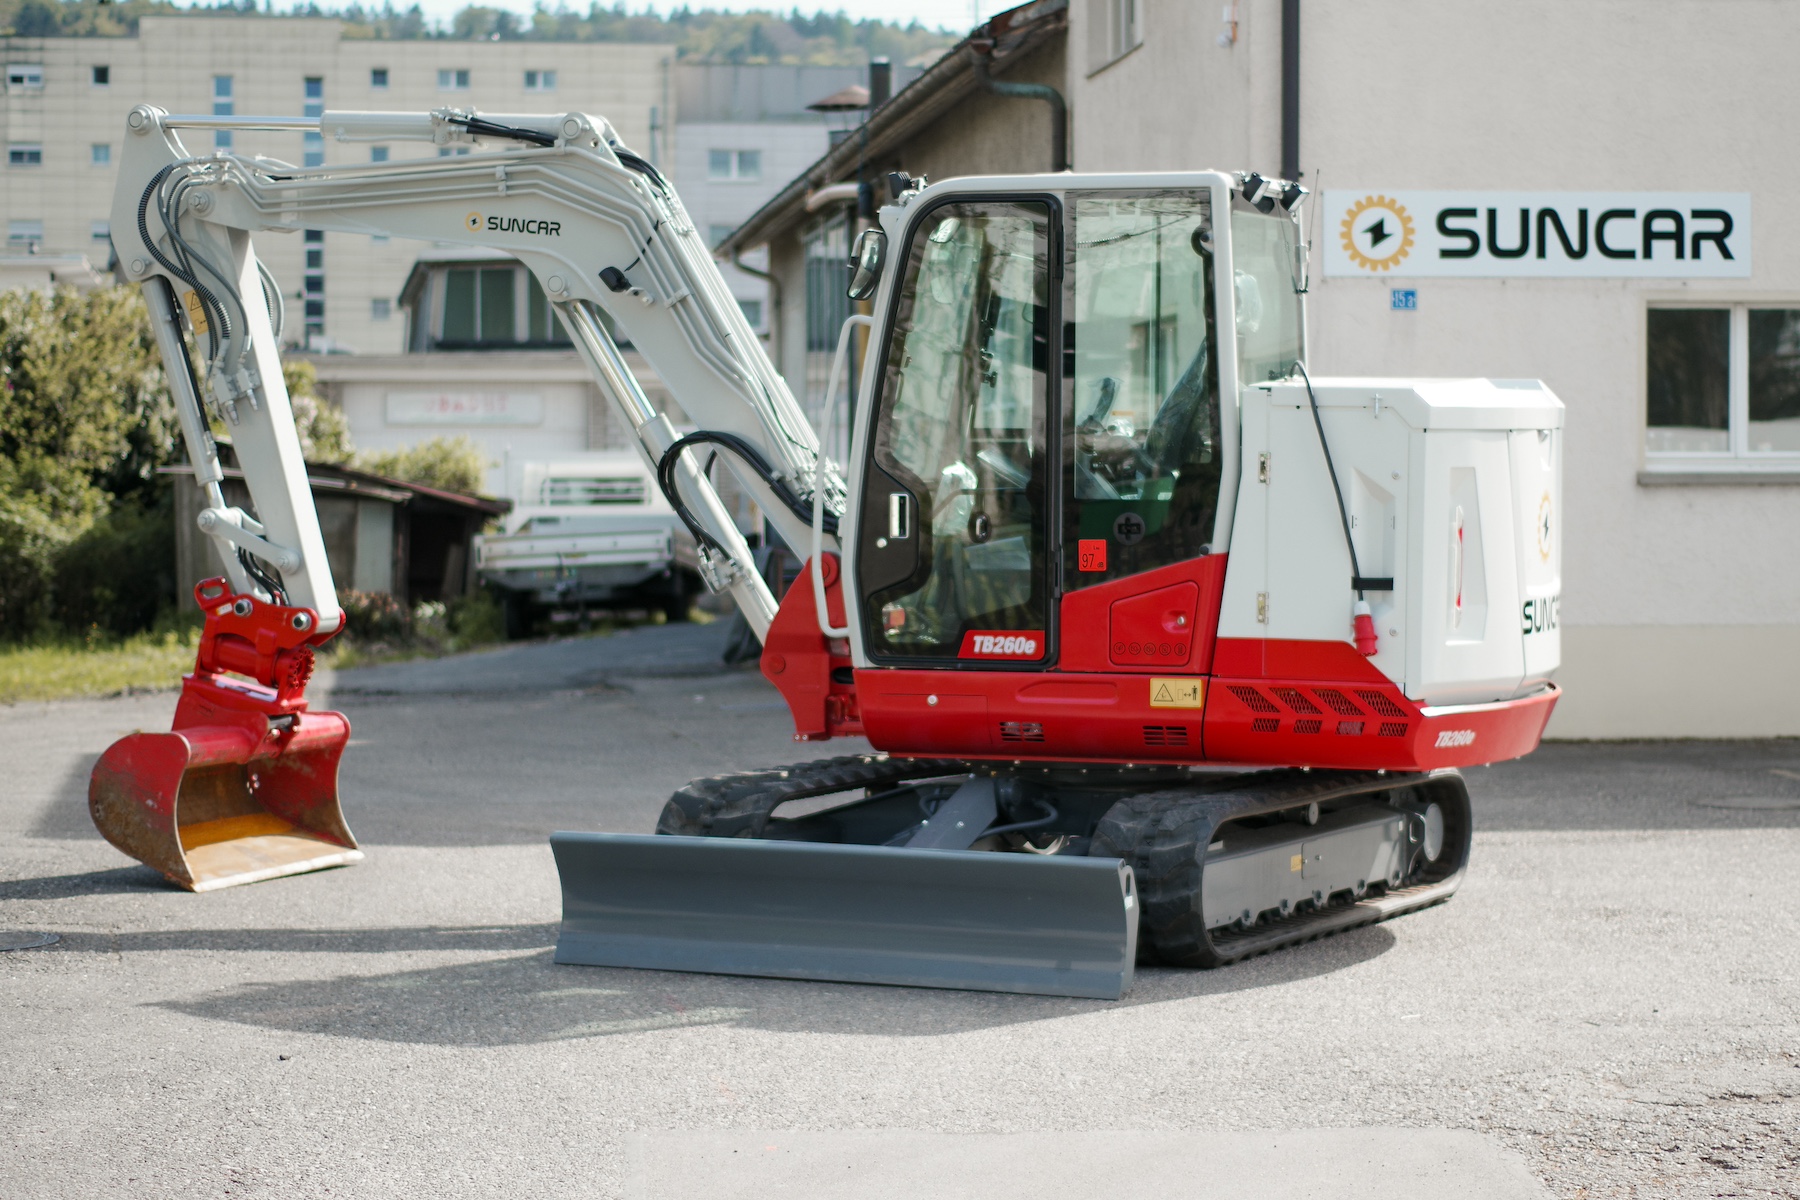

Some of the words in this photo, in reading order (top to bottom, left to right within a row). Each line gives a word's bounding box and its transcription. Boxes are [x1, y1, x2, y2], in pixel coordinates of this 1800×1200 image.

[487, 216, 561, 236] SUNCAR
[1436, 207, 1735, 260] SUNCAR
[1081, 553, 1095, 568] 97
[1523, 595, 1560, 635] SUNC
[973, 635, 1036, 655] TB260e
